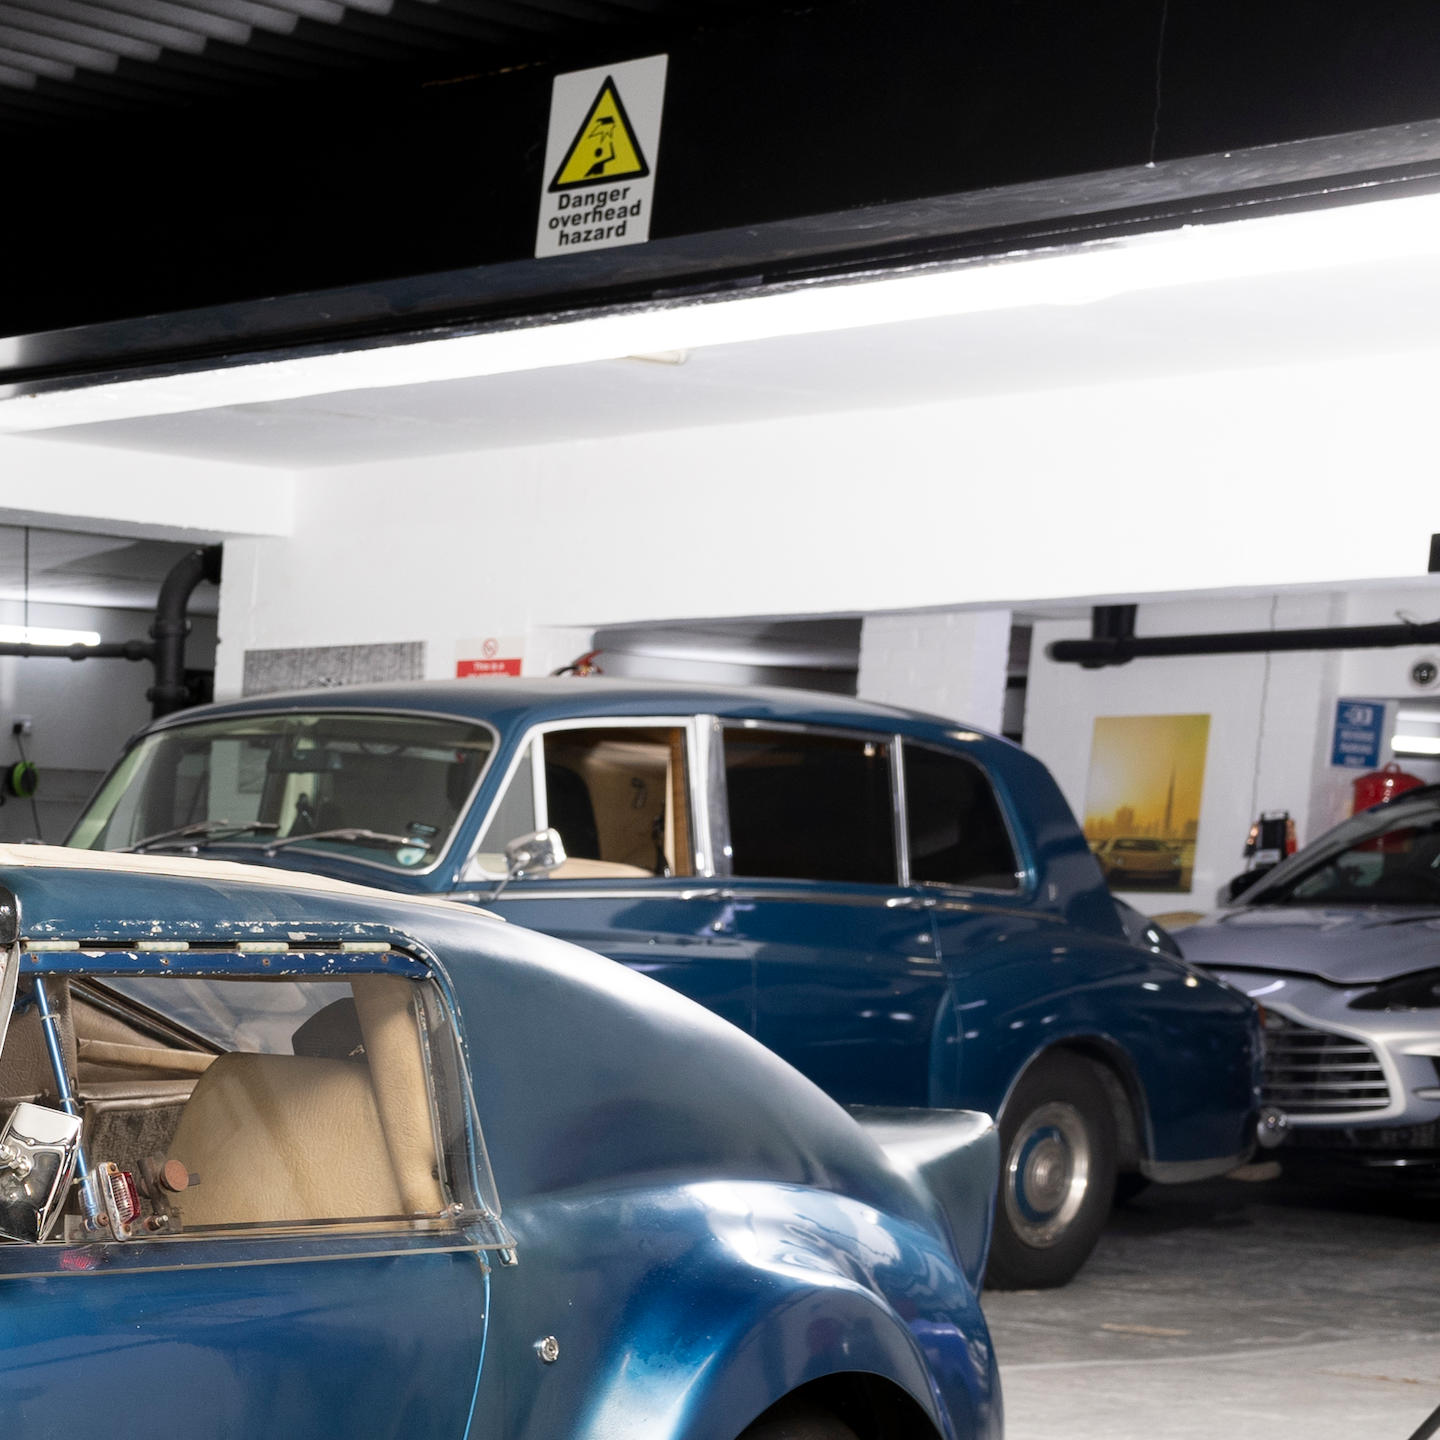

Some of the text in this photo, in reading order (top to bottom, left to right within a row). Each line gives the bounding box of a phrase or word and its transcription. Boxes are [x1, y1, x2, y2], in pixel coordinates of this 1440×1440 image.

[558, 187, 630, 211] Danger
[548, 199, 641, 230] overhead
[558, 221, 627, 247] hazard
